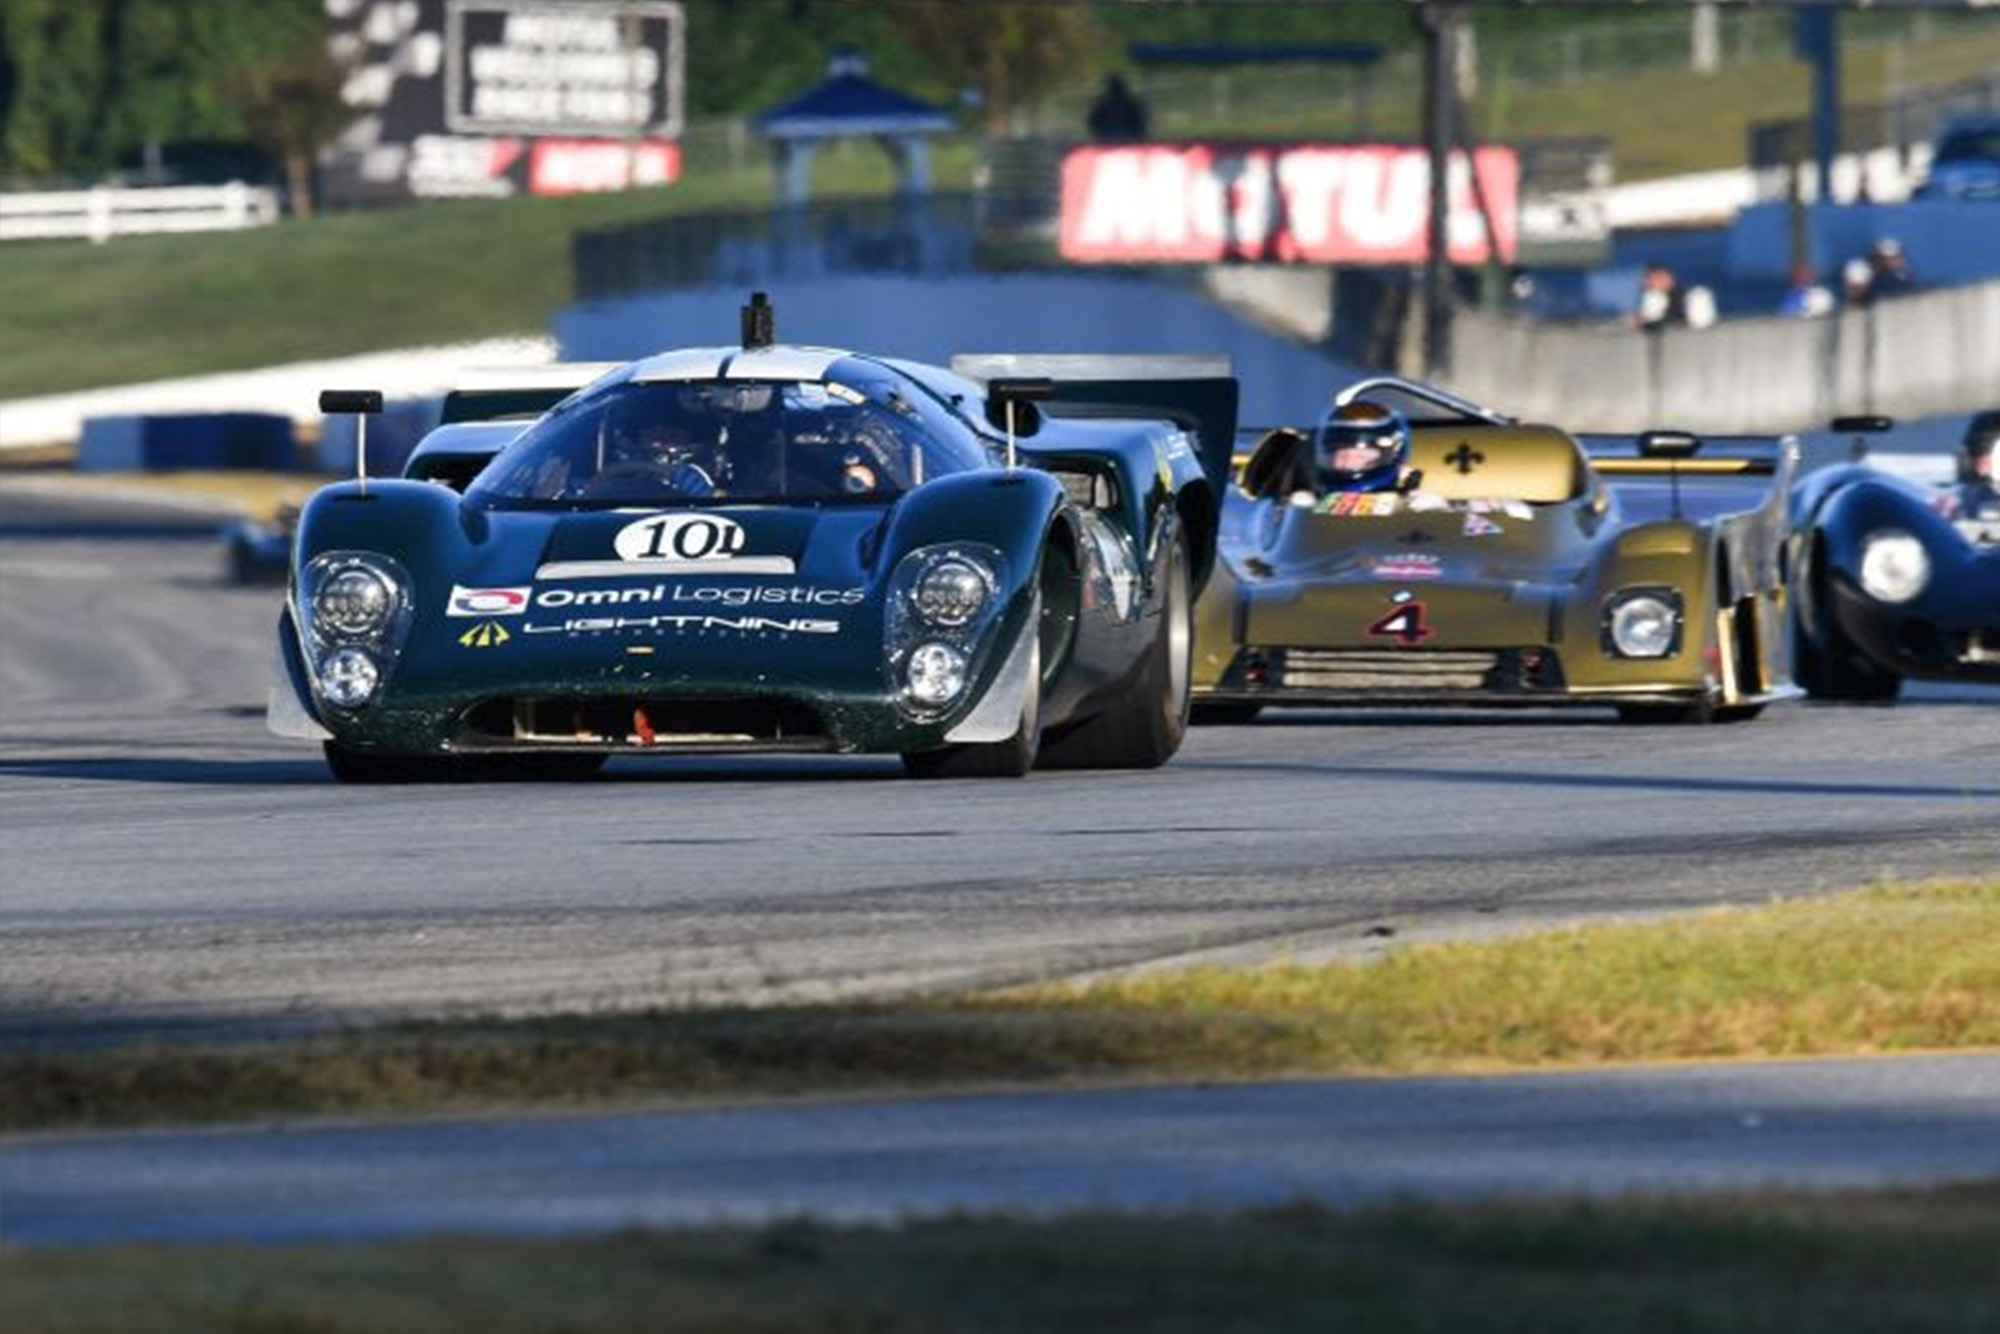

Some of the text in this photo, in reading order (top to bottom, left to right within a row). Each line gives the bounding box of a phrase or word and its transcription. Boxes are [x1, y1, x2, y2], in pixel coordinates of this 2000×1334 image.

[536, 584, 865, 606] Omni Logistics
[523, 616, 840, 634] LIGHTNING
[1370, 602, 1432, 644] 4
